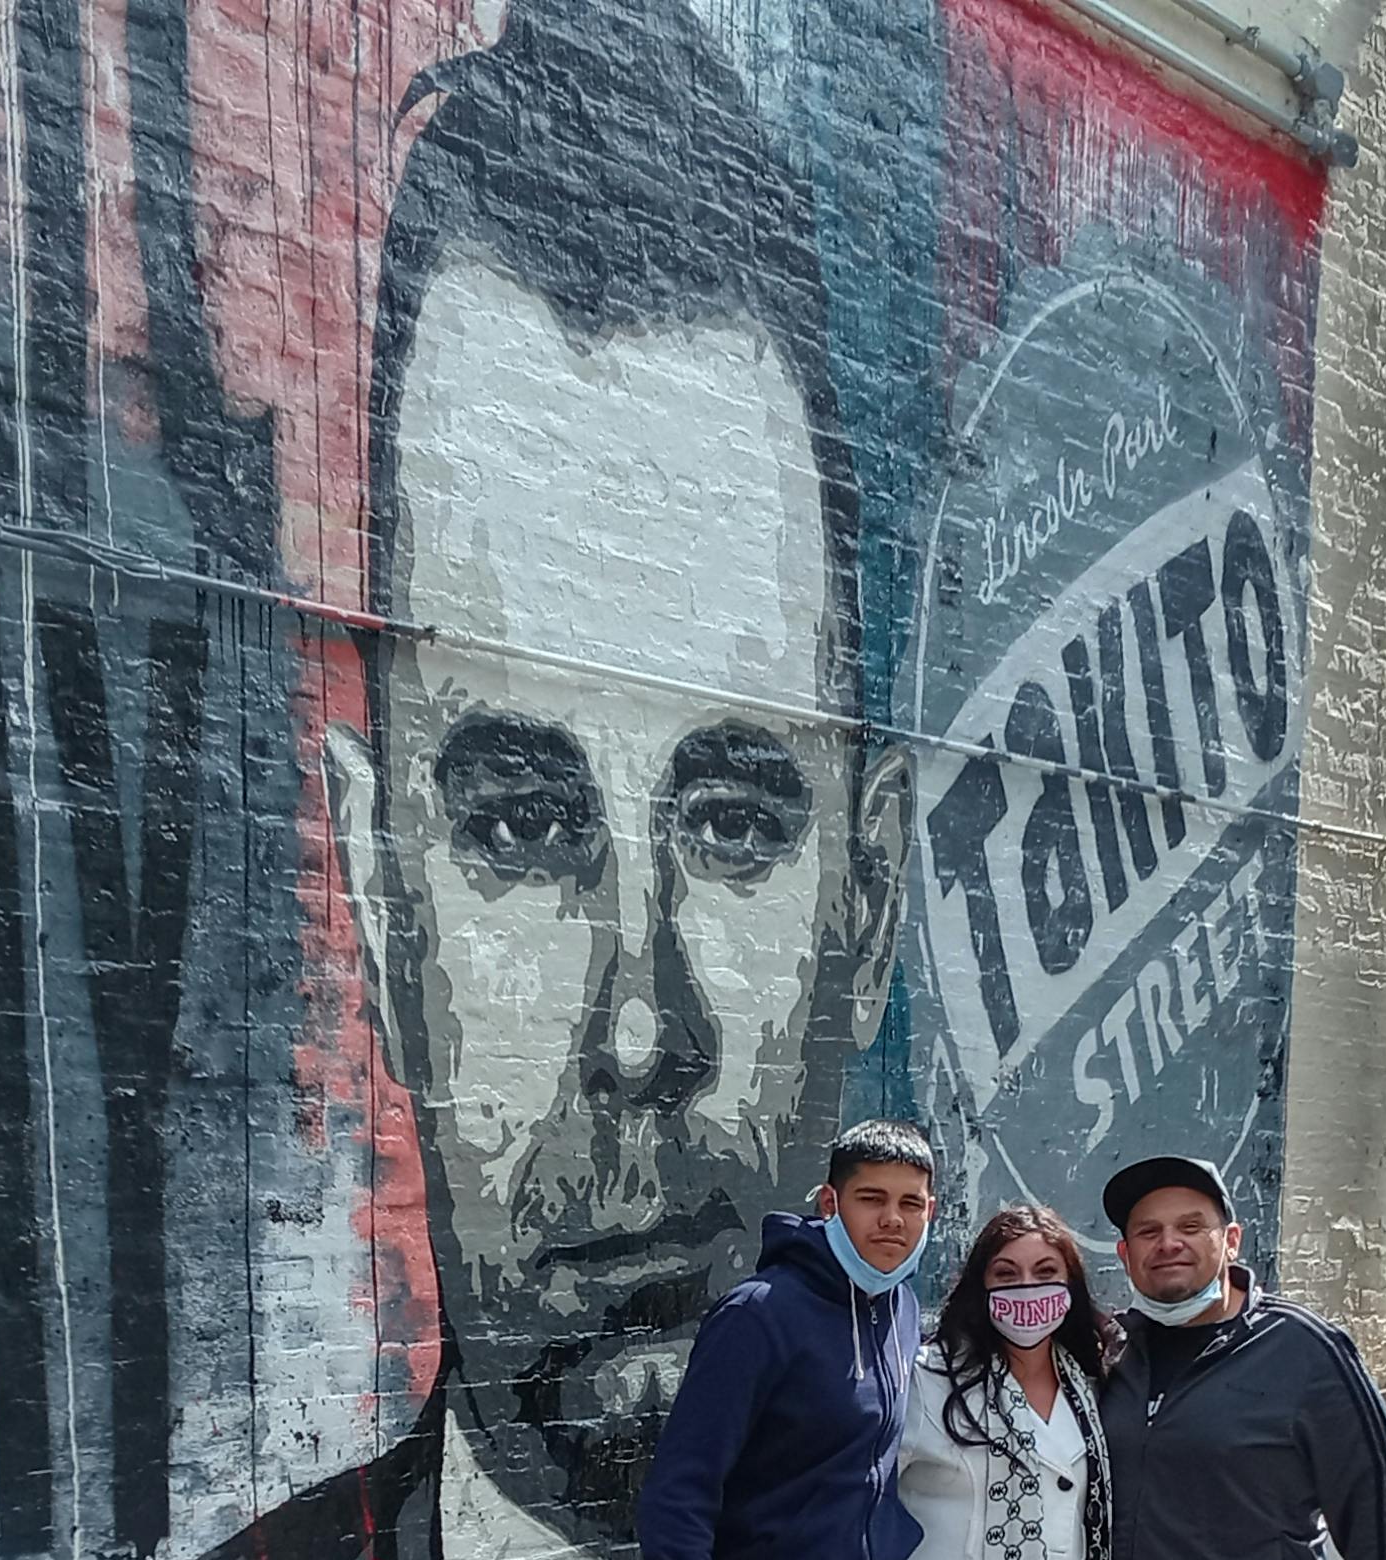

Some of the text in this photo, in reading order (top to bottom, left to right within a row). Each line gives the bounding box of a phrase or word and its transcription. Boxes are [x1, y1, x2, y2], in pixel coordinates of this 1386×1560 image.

[979, 384, 1186, 606] Lincoln Park
[1072, 849, 1268, 1154] STREET
[992, 1290, 1069, 1328] PINK
